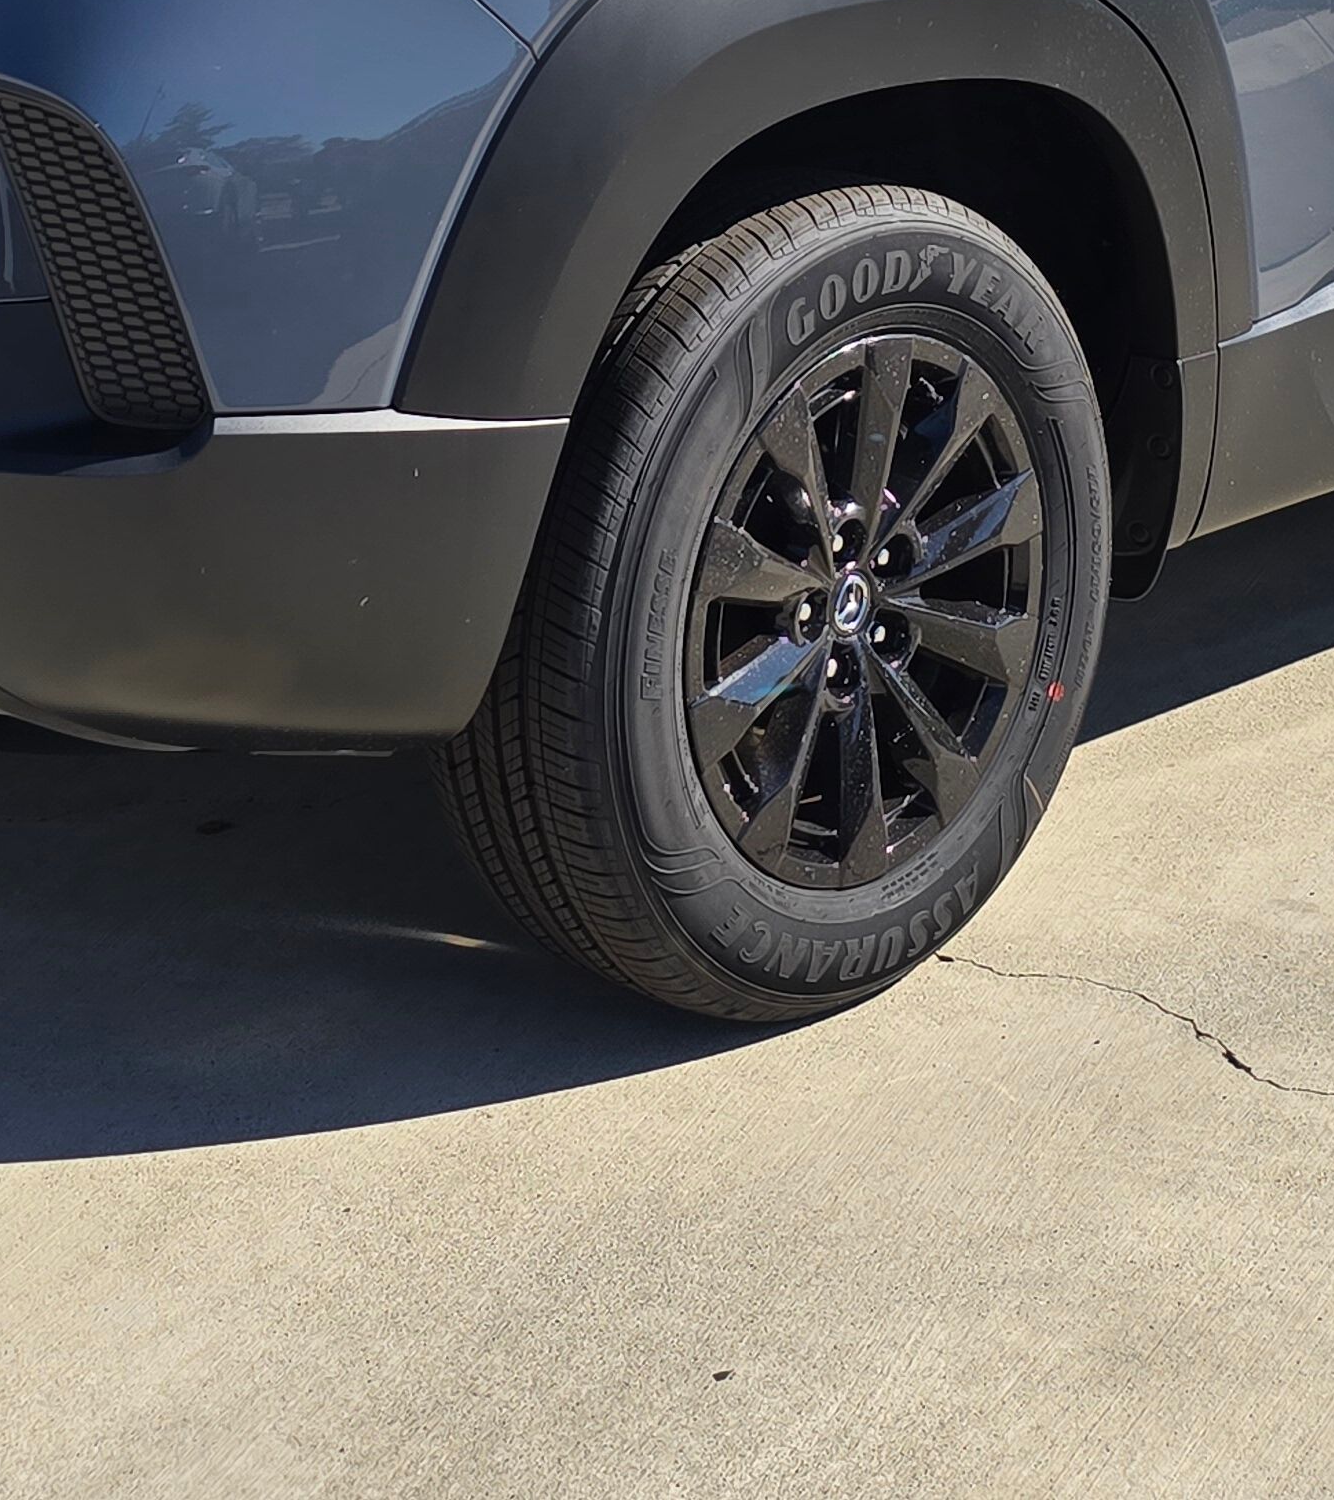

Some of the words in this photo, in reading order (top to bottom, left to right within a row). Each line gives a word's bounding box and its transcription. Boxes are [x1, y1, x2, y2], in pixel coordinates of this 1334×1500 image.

[785, 248, 1048, 355] GOODYEAR
[640, 549, 677, 700] FINESSE
[711, 861, 979, 983] ASSURANCE
